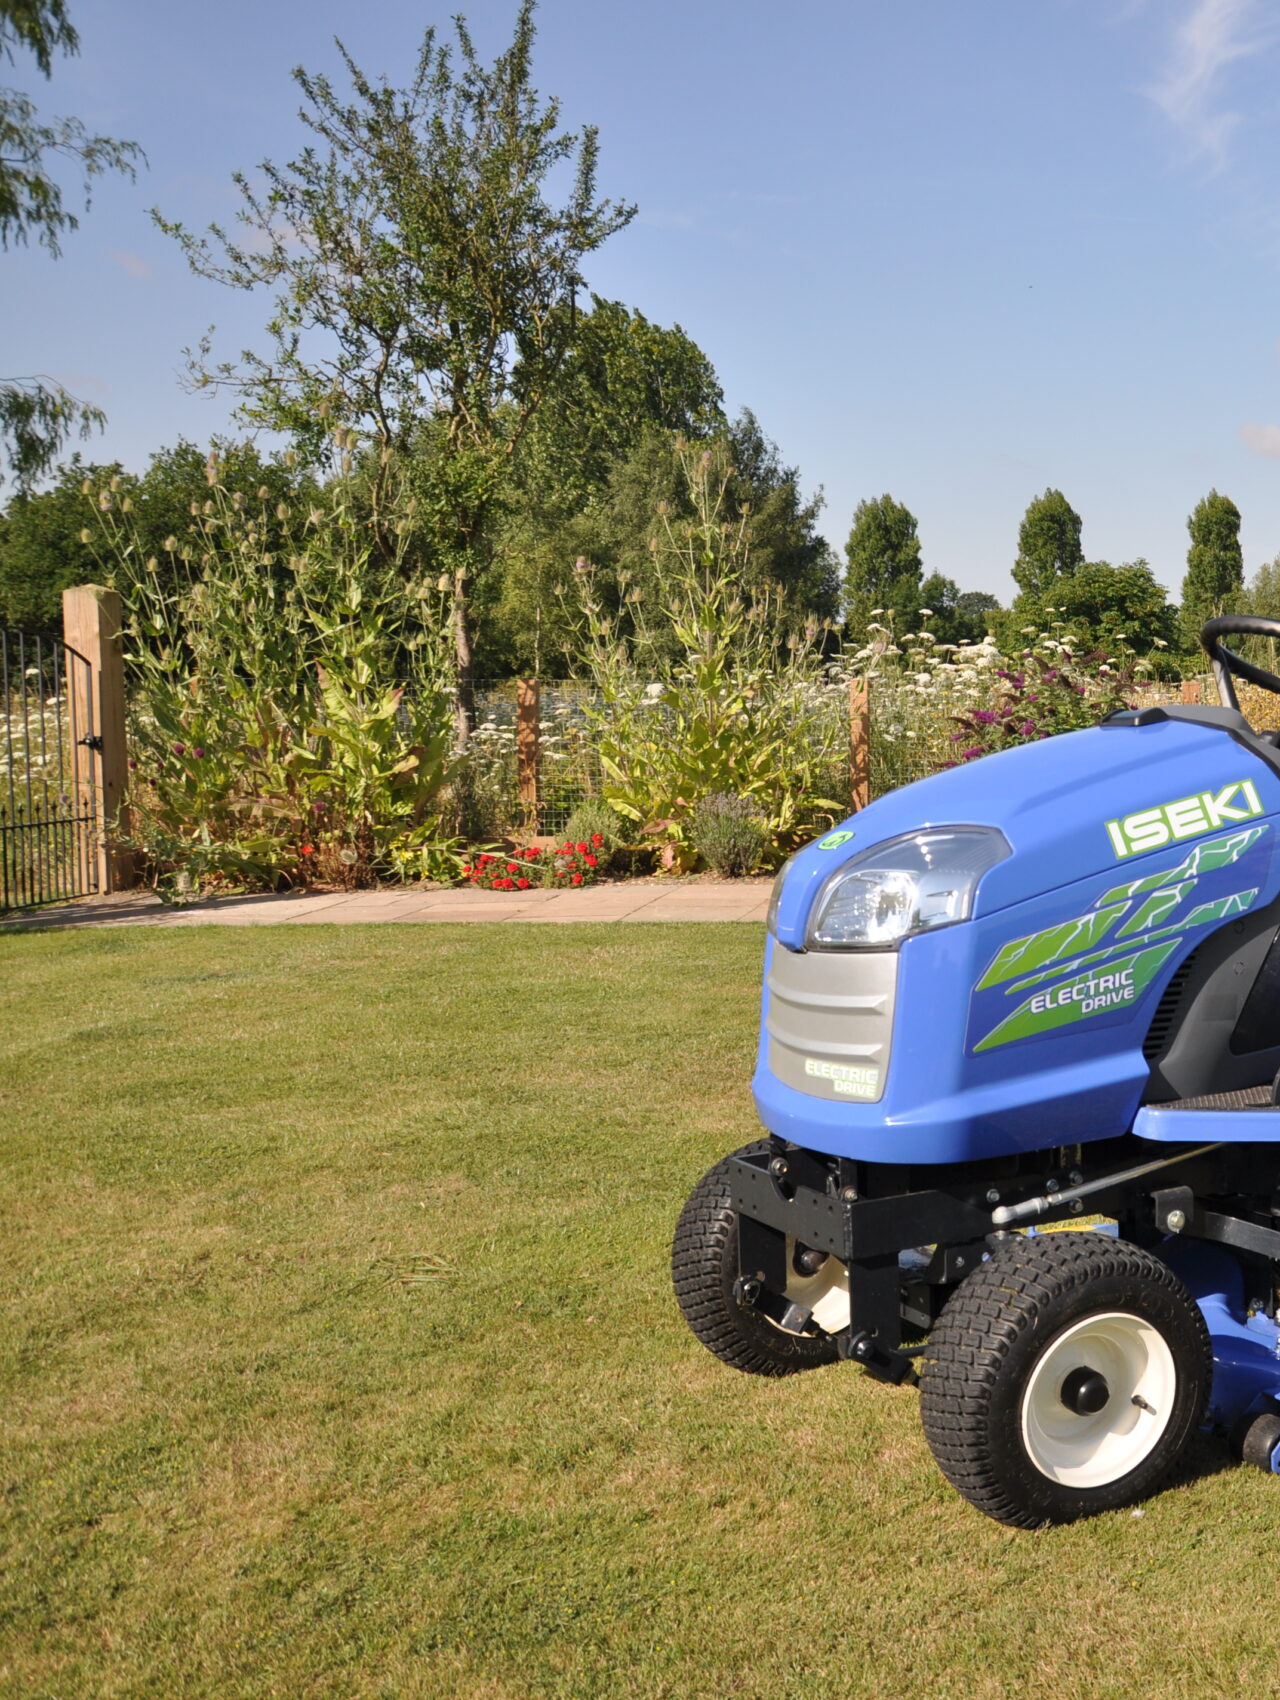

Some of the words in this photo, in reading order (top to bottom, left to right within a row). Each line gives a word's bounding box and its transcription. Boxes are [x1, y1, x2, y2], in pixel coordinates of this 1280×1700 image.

[1105, 779, 1263, 859] ISEKI
[1030, 968, 1134, 1014] ELECTRIC
[1081, 985, 1135, 1014] DRIVE
[804, 1059, 879, 1085] ELECTRIC
[833, 1079, 876, 1098] DRIVE
